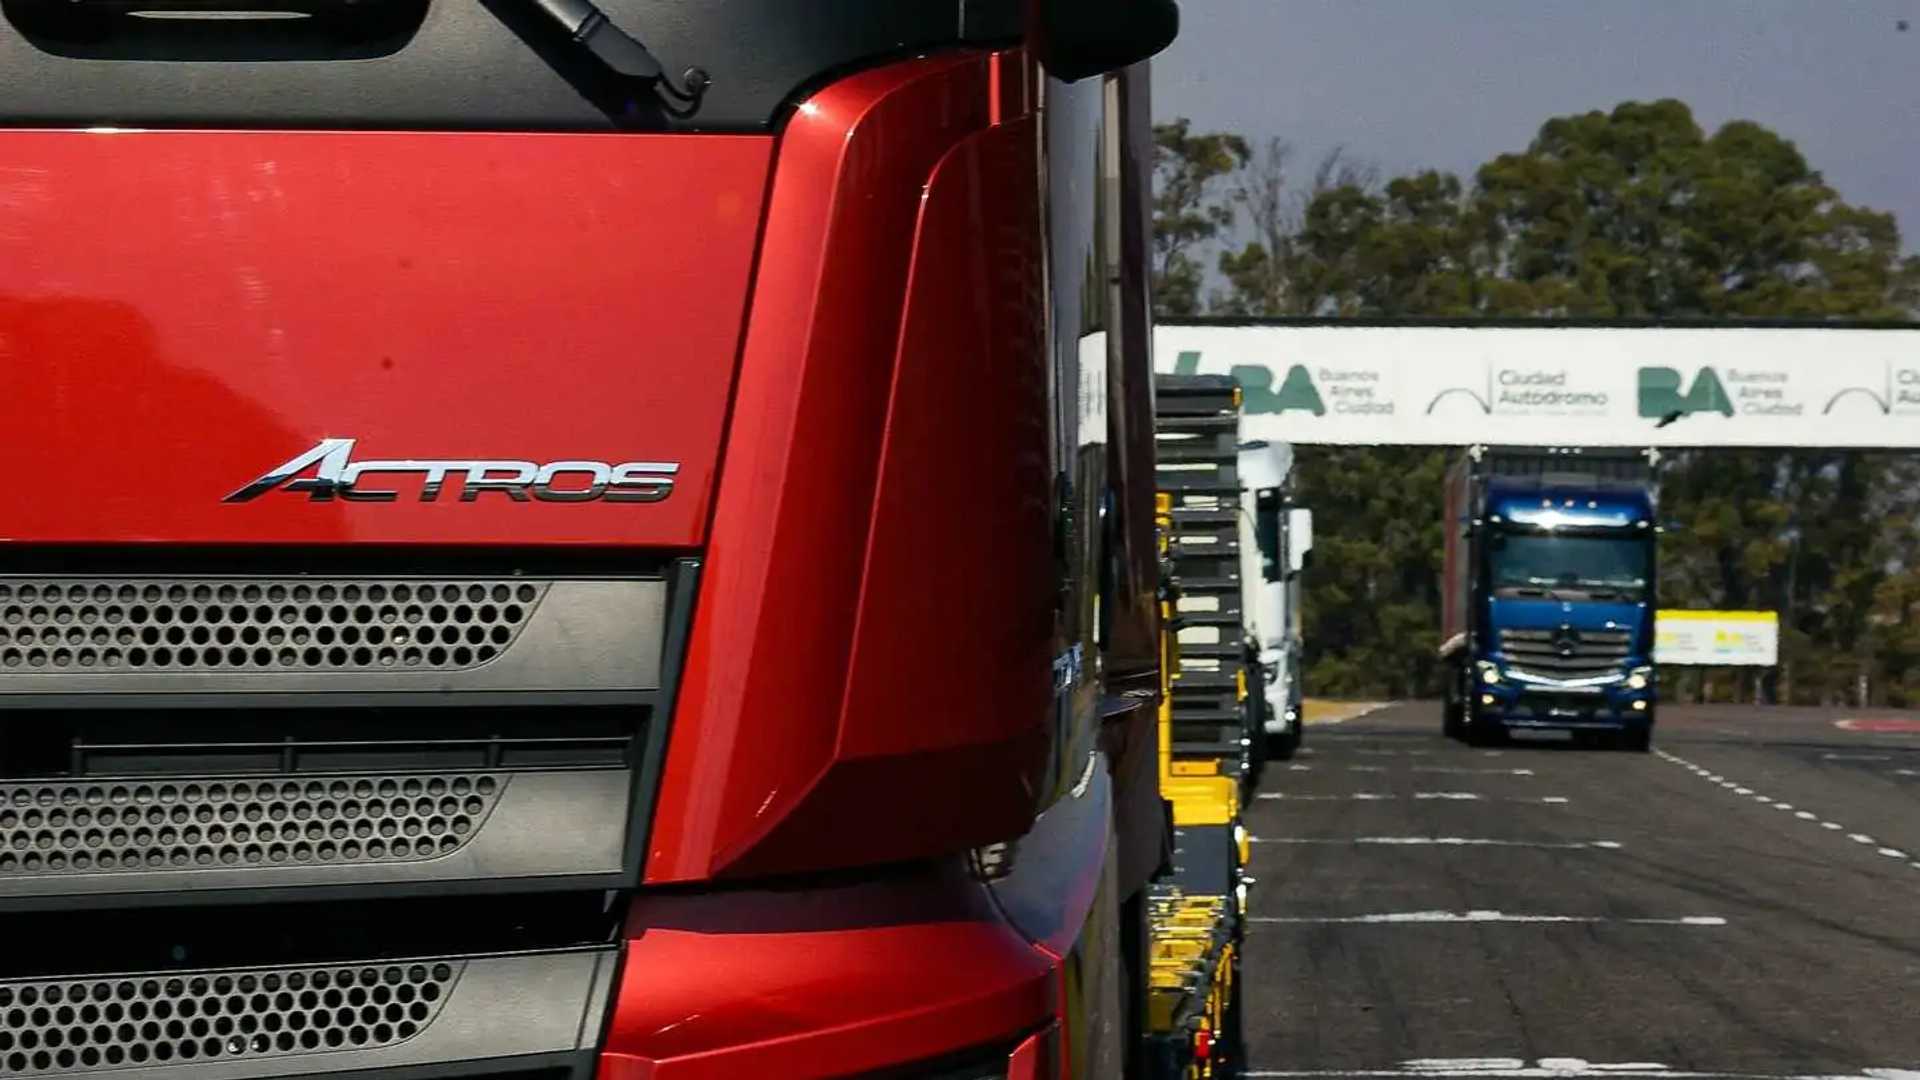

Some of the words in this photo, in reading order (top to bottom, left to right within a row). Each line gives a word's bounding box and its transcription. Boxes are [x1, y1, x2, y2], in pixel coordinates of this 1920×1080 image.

[1498, 369, 1566, 386] Ciudad
[1638, 366, 1734, 418] BA
[222, 437, 681, 504] ACTROS
